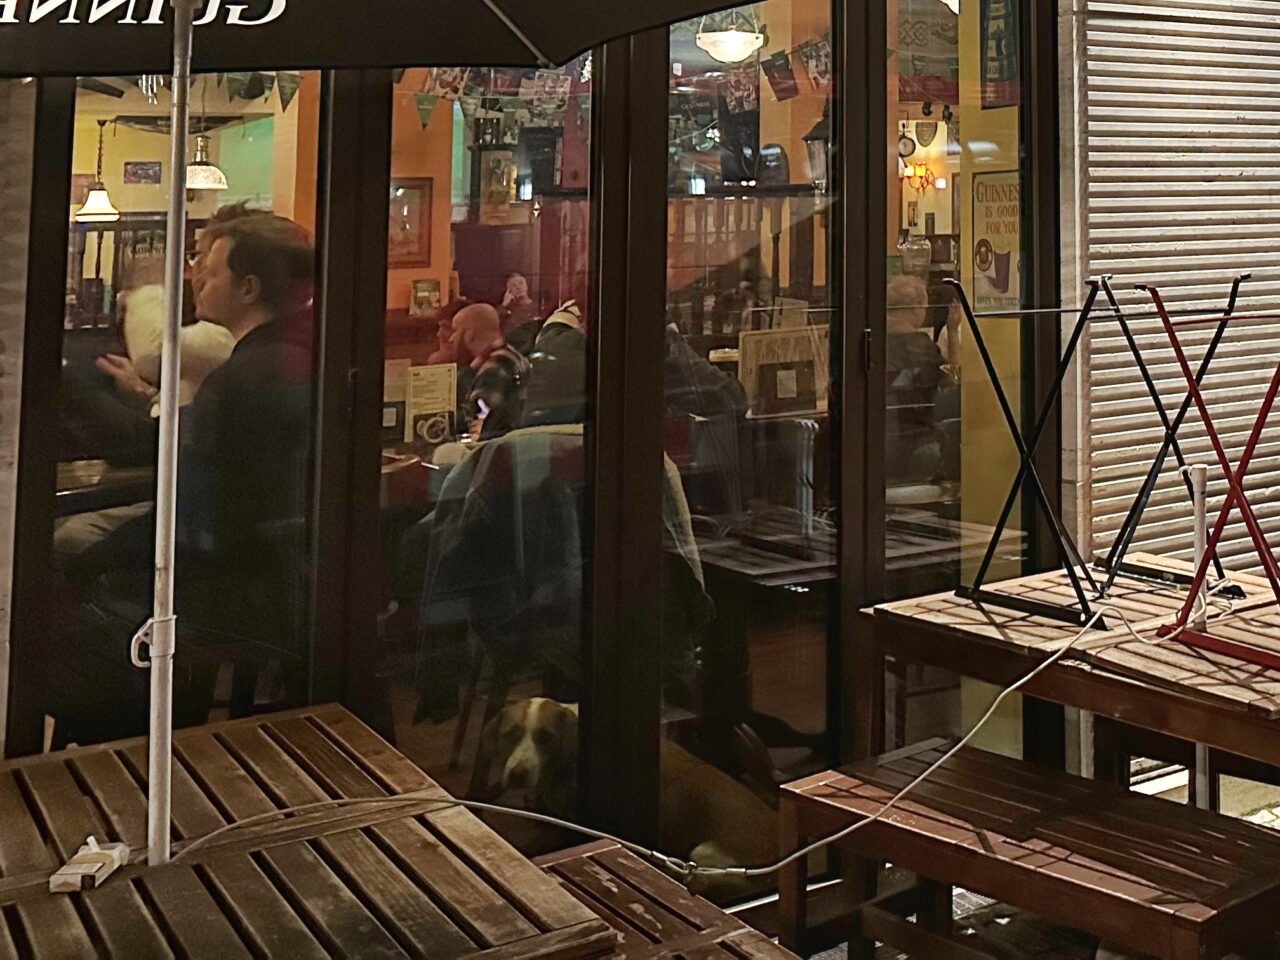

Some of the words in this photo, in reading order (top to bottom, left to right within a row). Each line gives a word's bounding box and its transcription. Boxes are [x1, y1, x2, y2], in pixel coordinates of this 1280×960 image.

[985, 205, 993, 218] IS
[997, 204, 1018, 218] GOOD
[985, 221, 1001, 234] FOR
[1002, 220, 1018, 234] YOU
